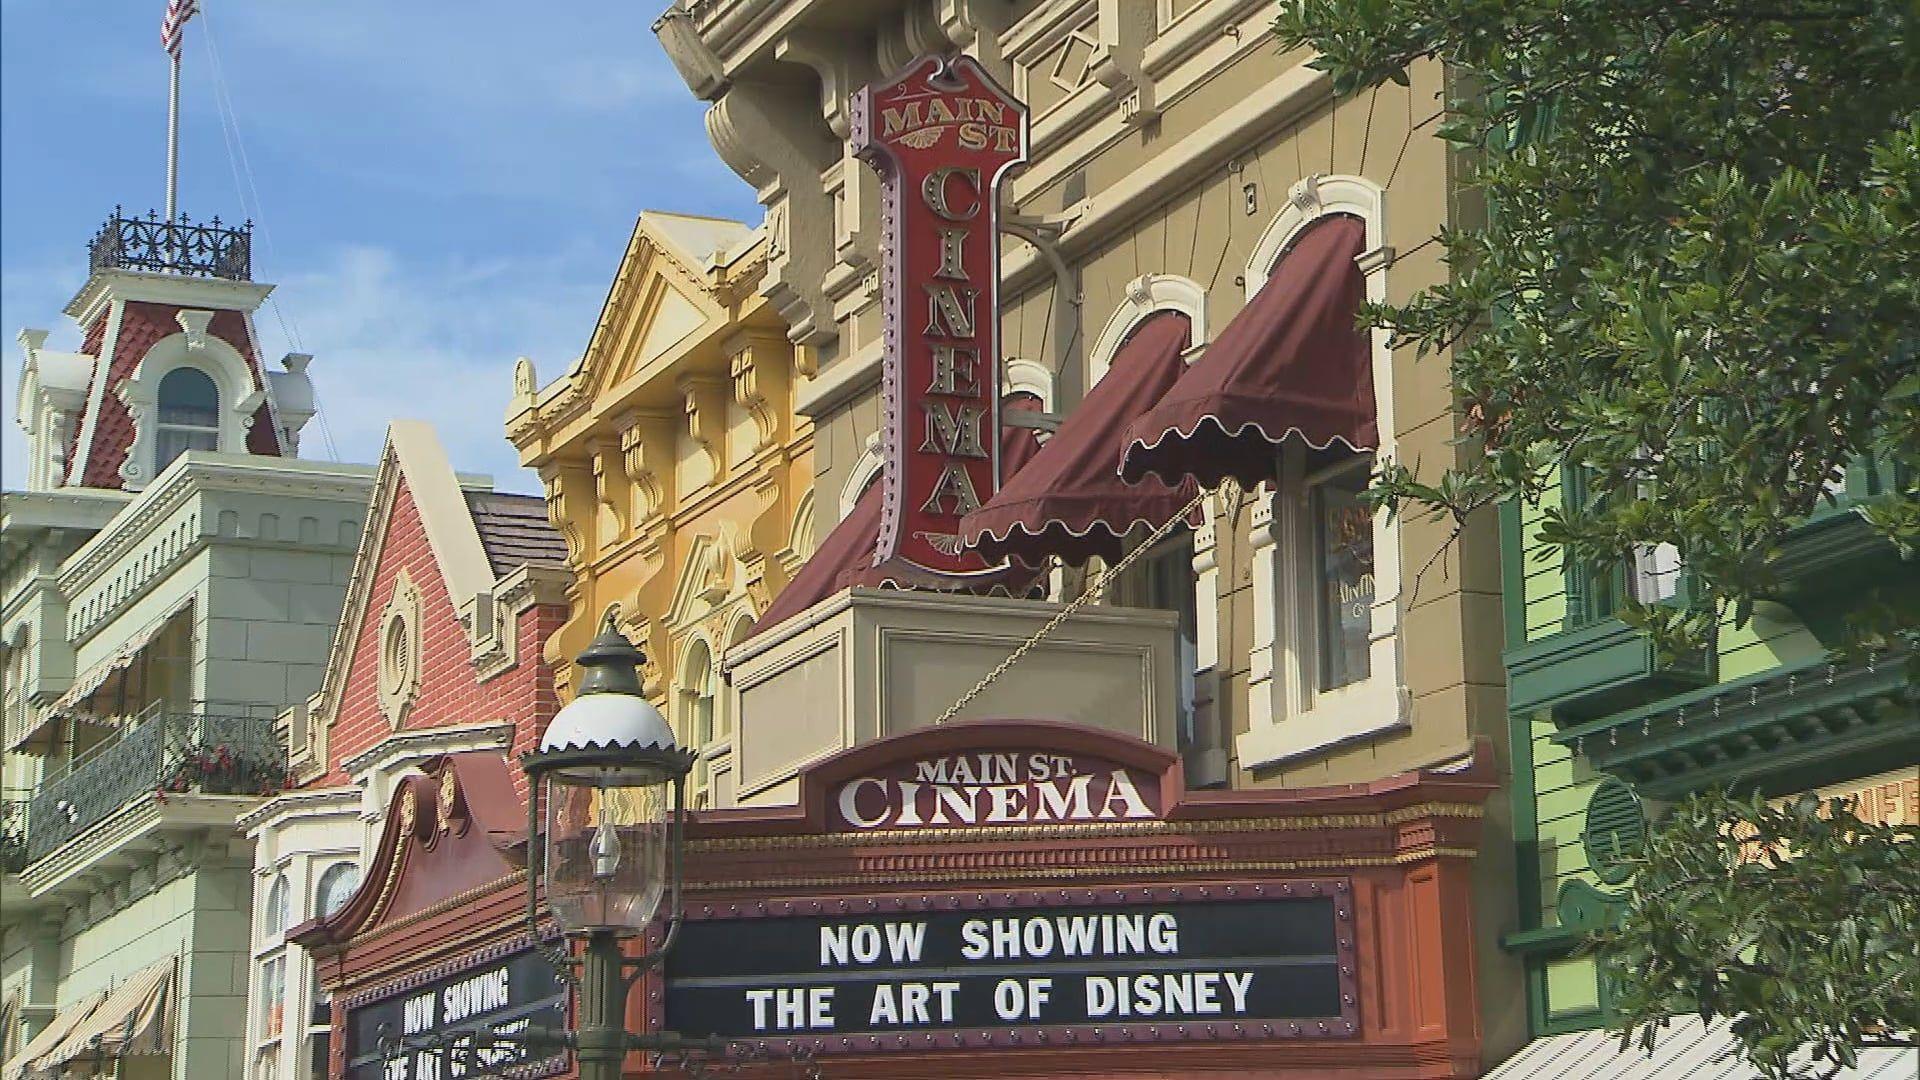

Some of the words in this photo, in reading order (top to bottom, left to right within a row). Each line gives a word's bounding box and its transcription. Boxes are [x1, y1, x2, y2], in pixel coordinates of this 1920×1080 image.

[882, 98, 1005, 137] MAIN
[959, 123, 1018, 152] ST.
[917, 167, 989, 517] CINEMA
[916, 753, 1019, 784] MAIN
[1028, 754, 1078, 781] ST.
[838, 768, 1156, 828] CINEMA
[819, 921, 928, 966] NOW
[960, 913, 1180, 960] SHOWING
[403, 991, 436, 1036] NOW
[443, 966, 510, 1025] SHOWING
[745, 987, 836, 1031] THE
[869, 981, 960, 1025] ART
[994, 977, 1053, 1021] OF
[1085, 971, 1255, 1018] DISNEY
